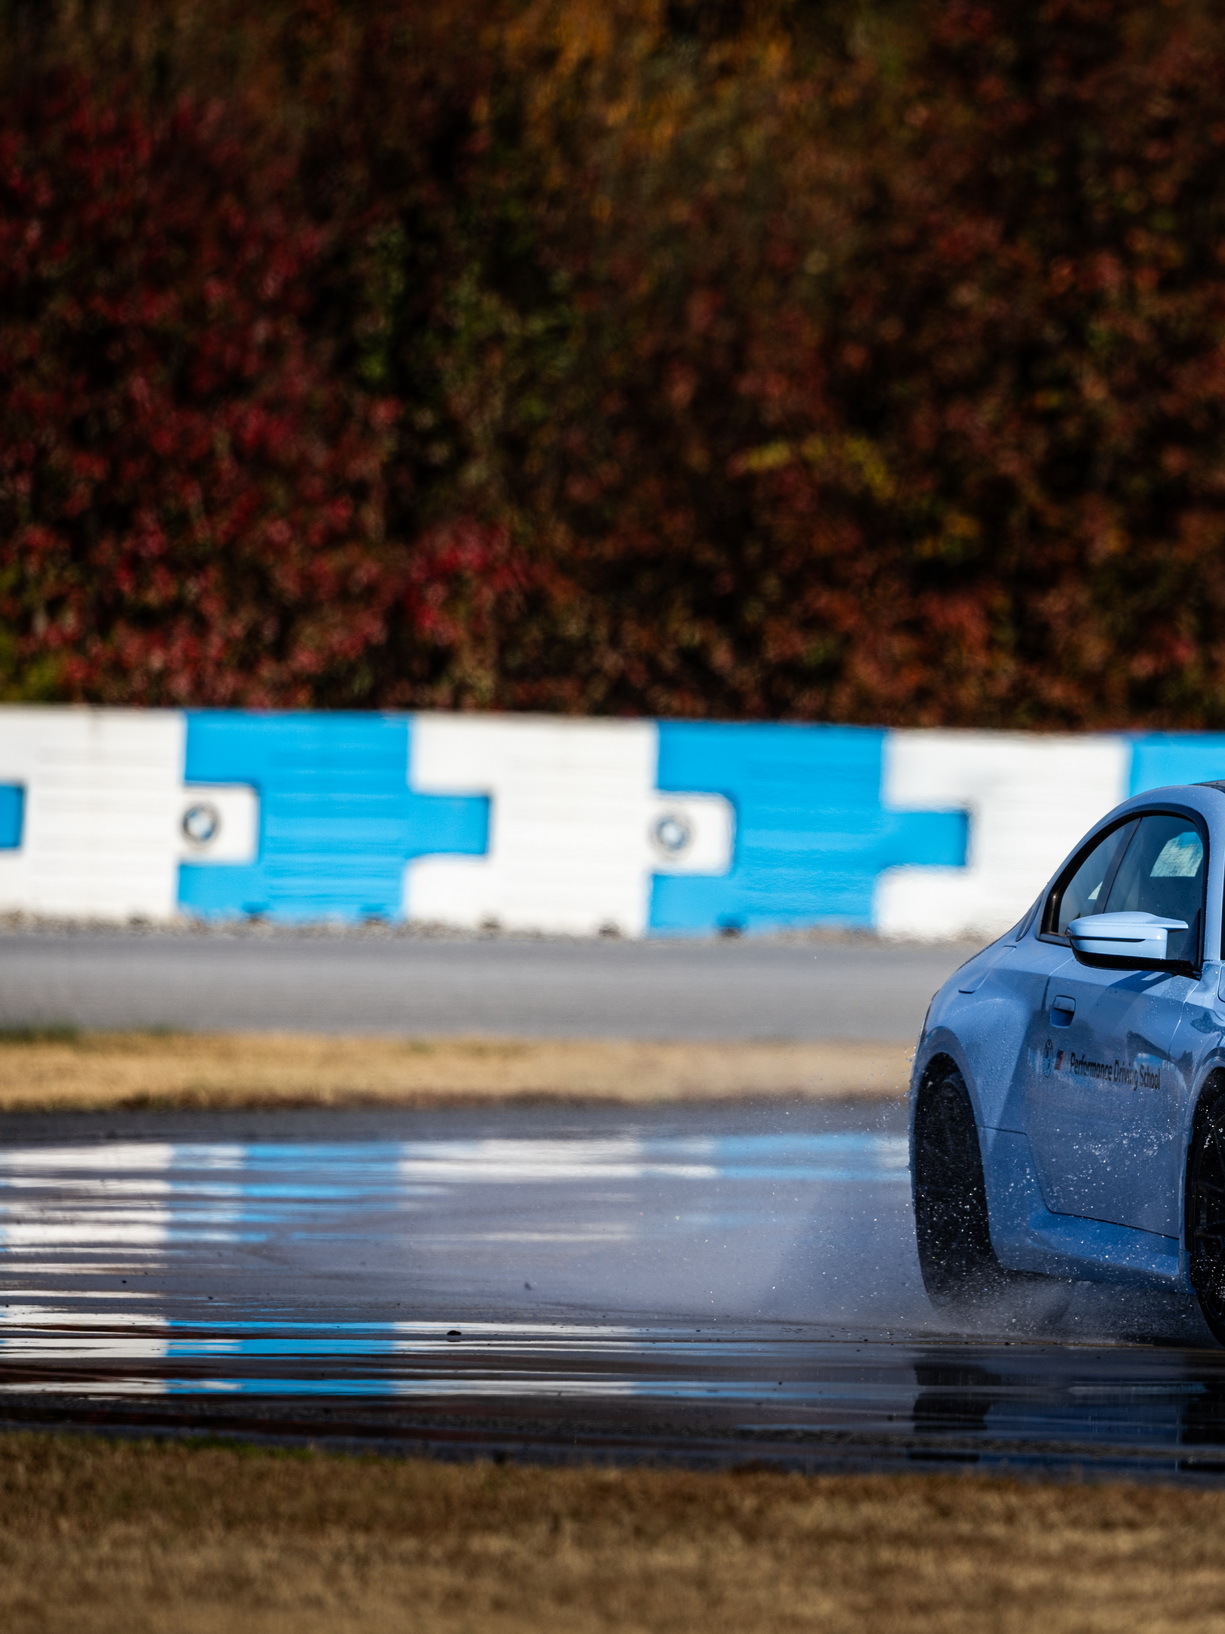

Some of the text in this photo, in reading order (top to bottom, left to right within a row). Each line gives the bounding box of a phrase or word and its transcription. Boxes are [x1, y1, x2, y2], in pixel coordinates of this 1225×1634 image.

[1070, 1052, 1161, 1091] Performance Driving School
